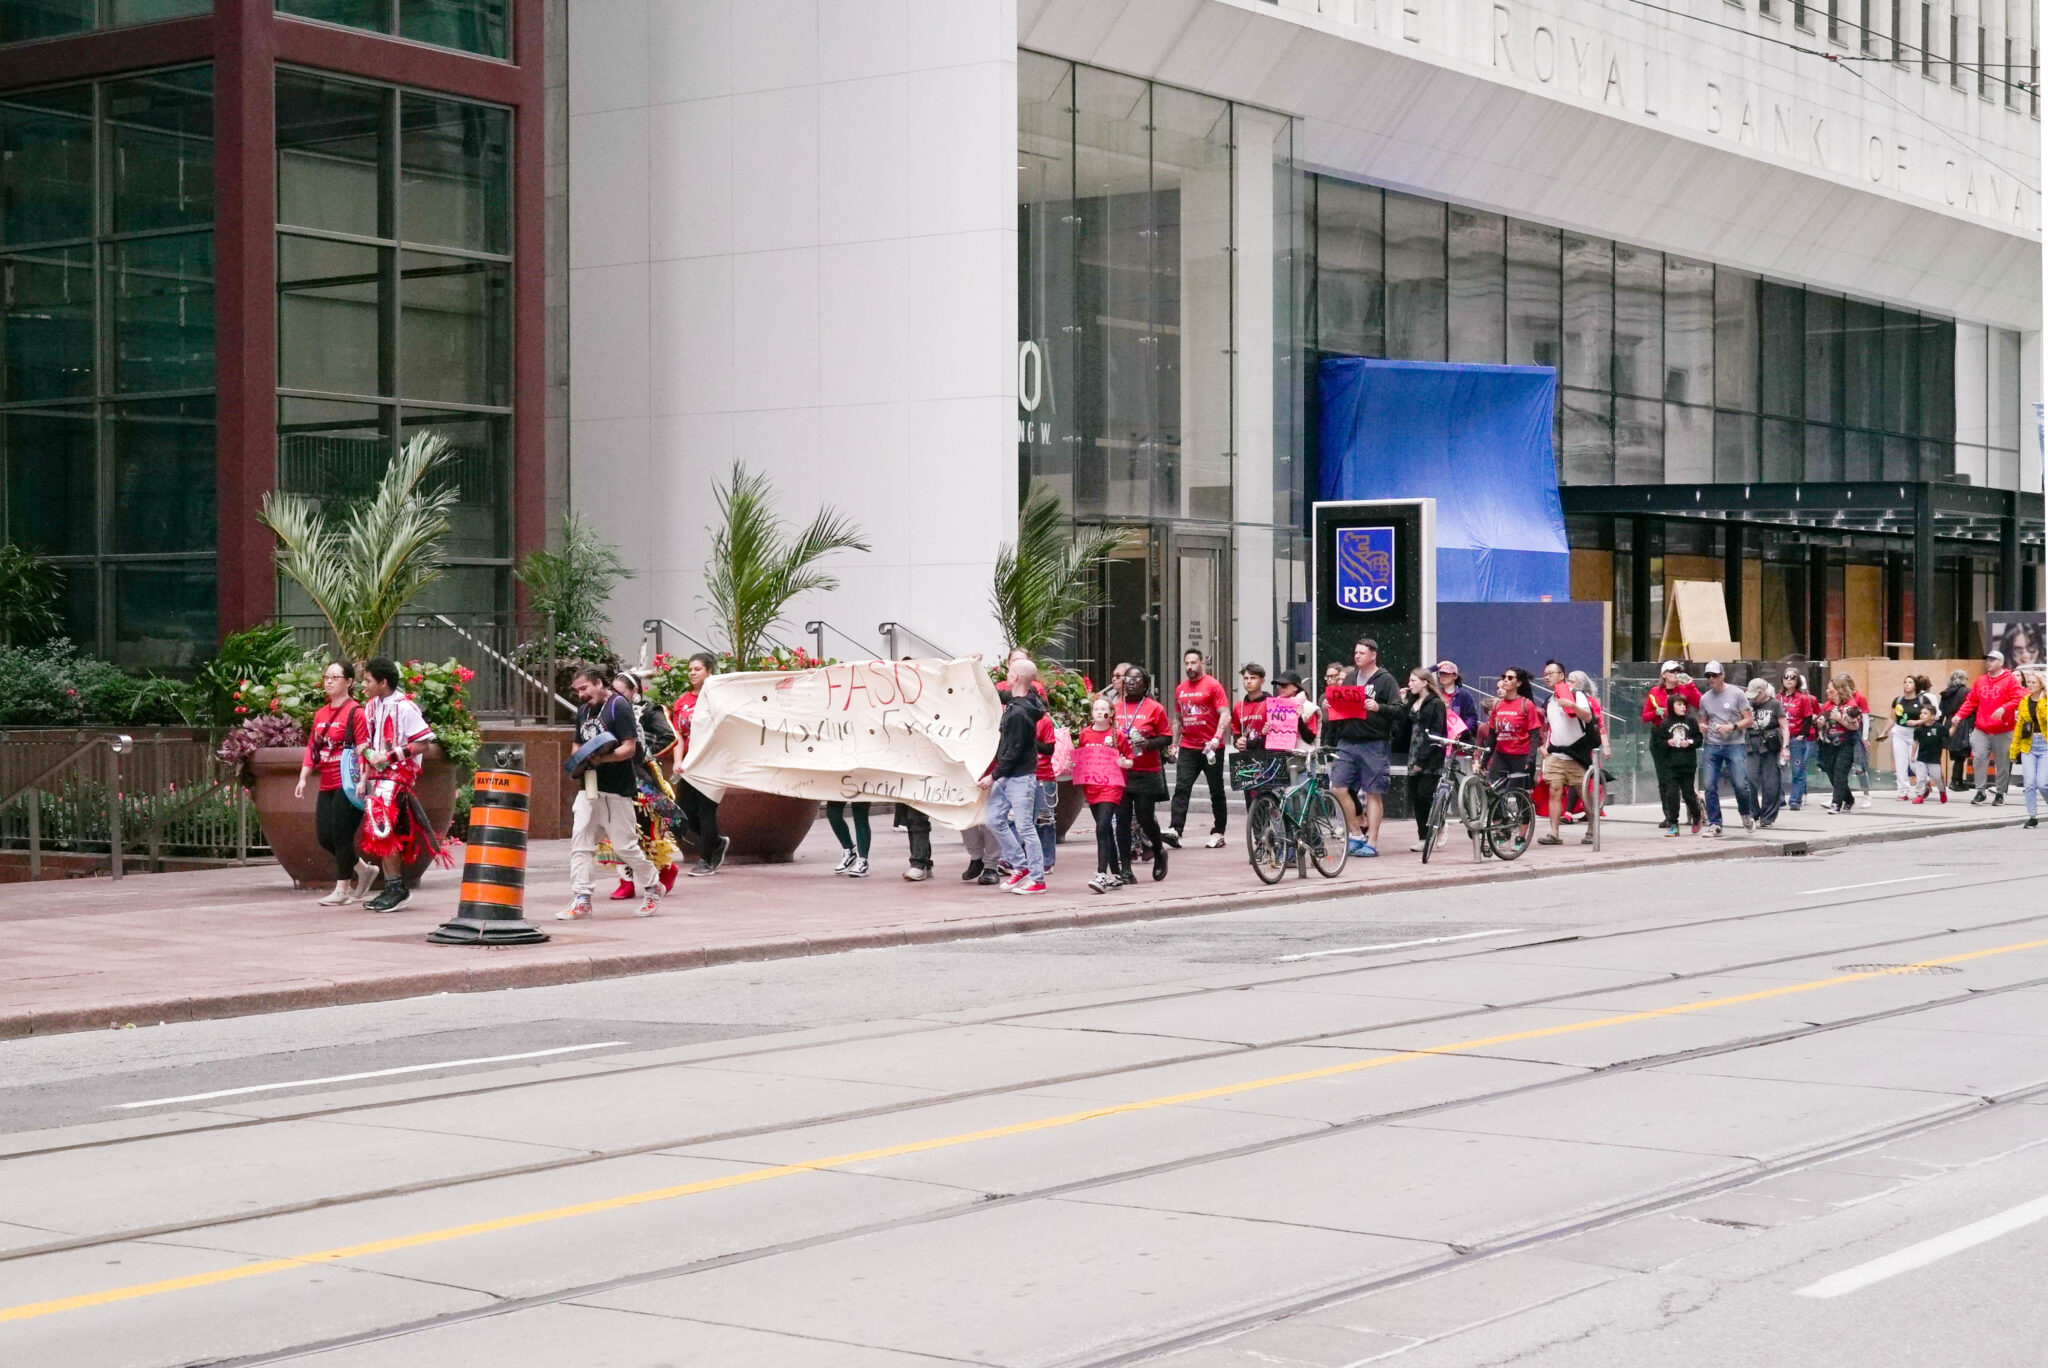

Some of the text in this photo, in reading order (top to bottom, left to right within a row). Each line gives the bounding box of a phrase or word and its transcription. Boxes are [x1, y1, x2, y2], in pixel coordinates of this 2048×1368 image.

[1493, 4, 1659, 116] ROYAL
[1706, 82, 1826, 167] BANK
[1868, 135, 1907, 192] OF
[1944, 160, 2041, 231] CANA
[1040, 423, 1052, 445] W.
[1344, 585, 1388, 603] RBC
[825, 661, 925, 711] FASD
[1332, 689, 1361, 704] FASD
[840, 775, 904, 799] Social
[913, 775, 965, 802] Justice
